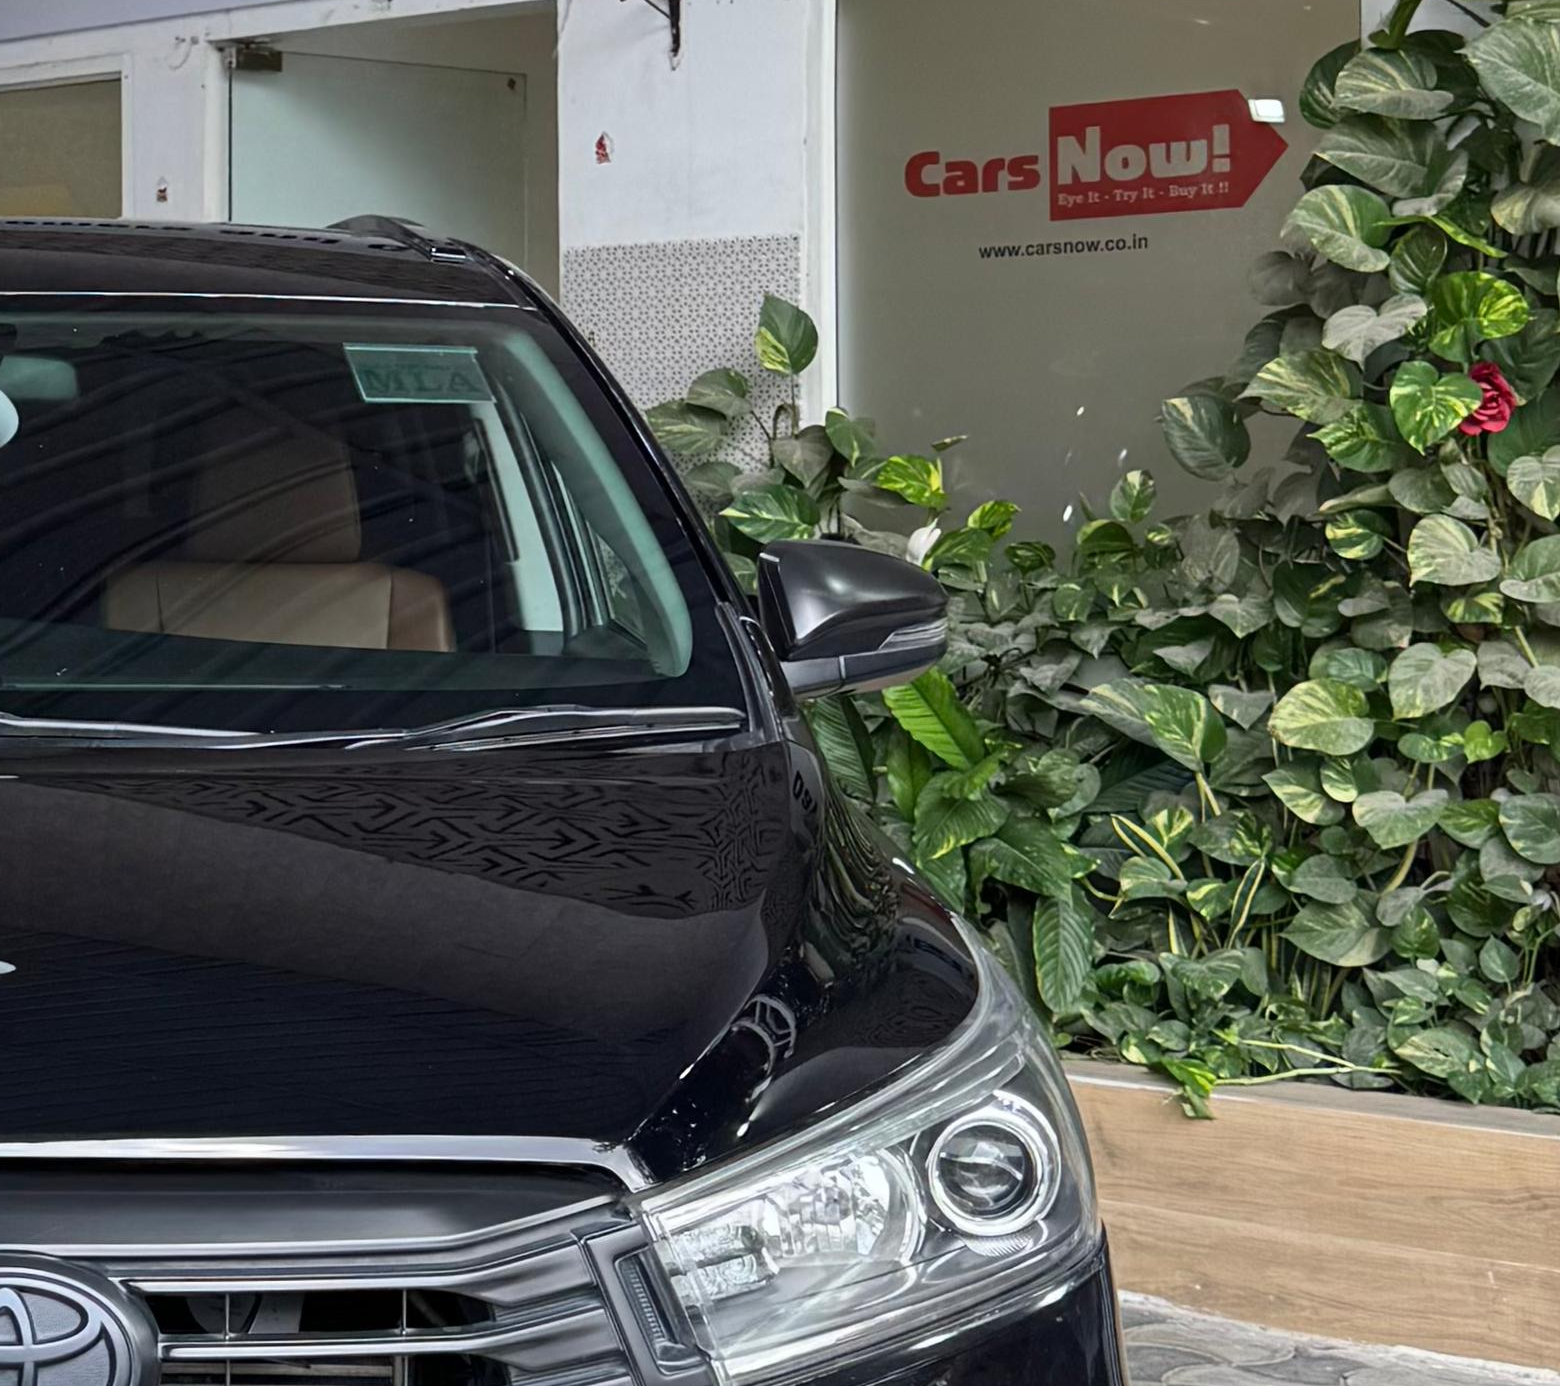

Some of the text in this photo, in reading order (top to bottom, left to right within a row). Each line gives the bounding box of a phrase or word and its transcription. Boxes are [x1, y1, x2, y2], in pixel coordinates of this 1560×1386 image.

[904, 124, 1231, 197] Cars Now!
[1057, 193, 1084, 208] Eye
[1089, 191, 1100, 202] It
[1112, 188, 1138, 206] Try
[1142, 187, 1155, 199] It
[1168, 184, 1198, 199] Buy
[1202, 182, 1214, 195] It
[978, 233, 1149, 259] www.carsnow.co.in
